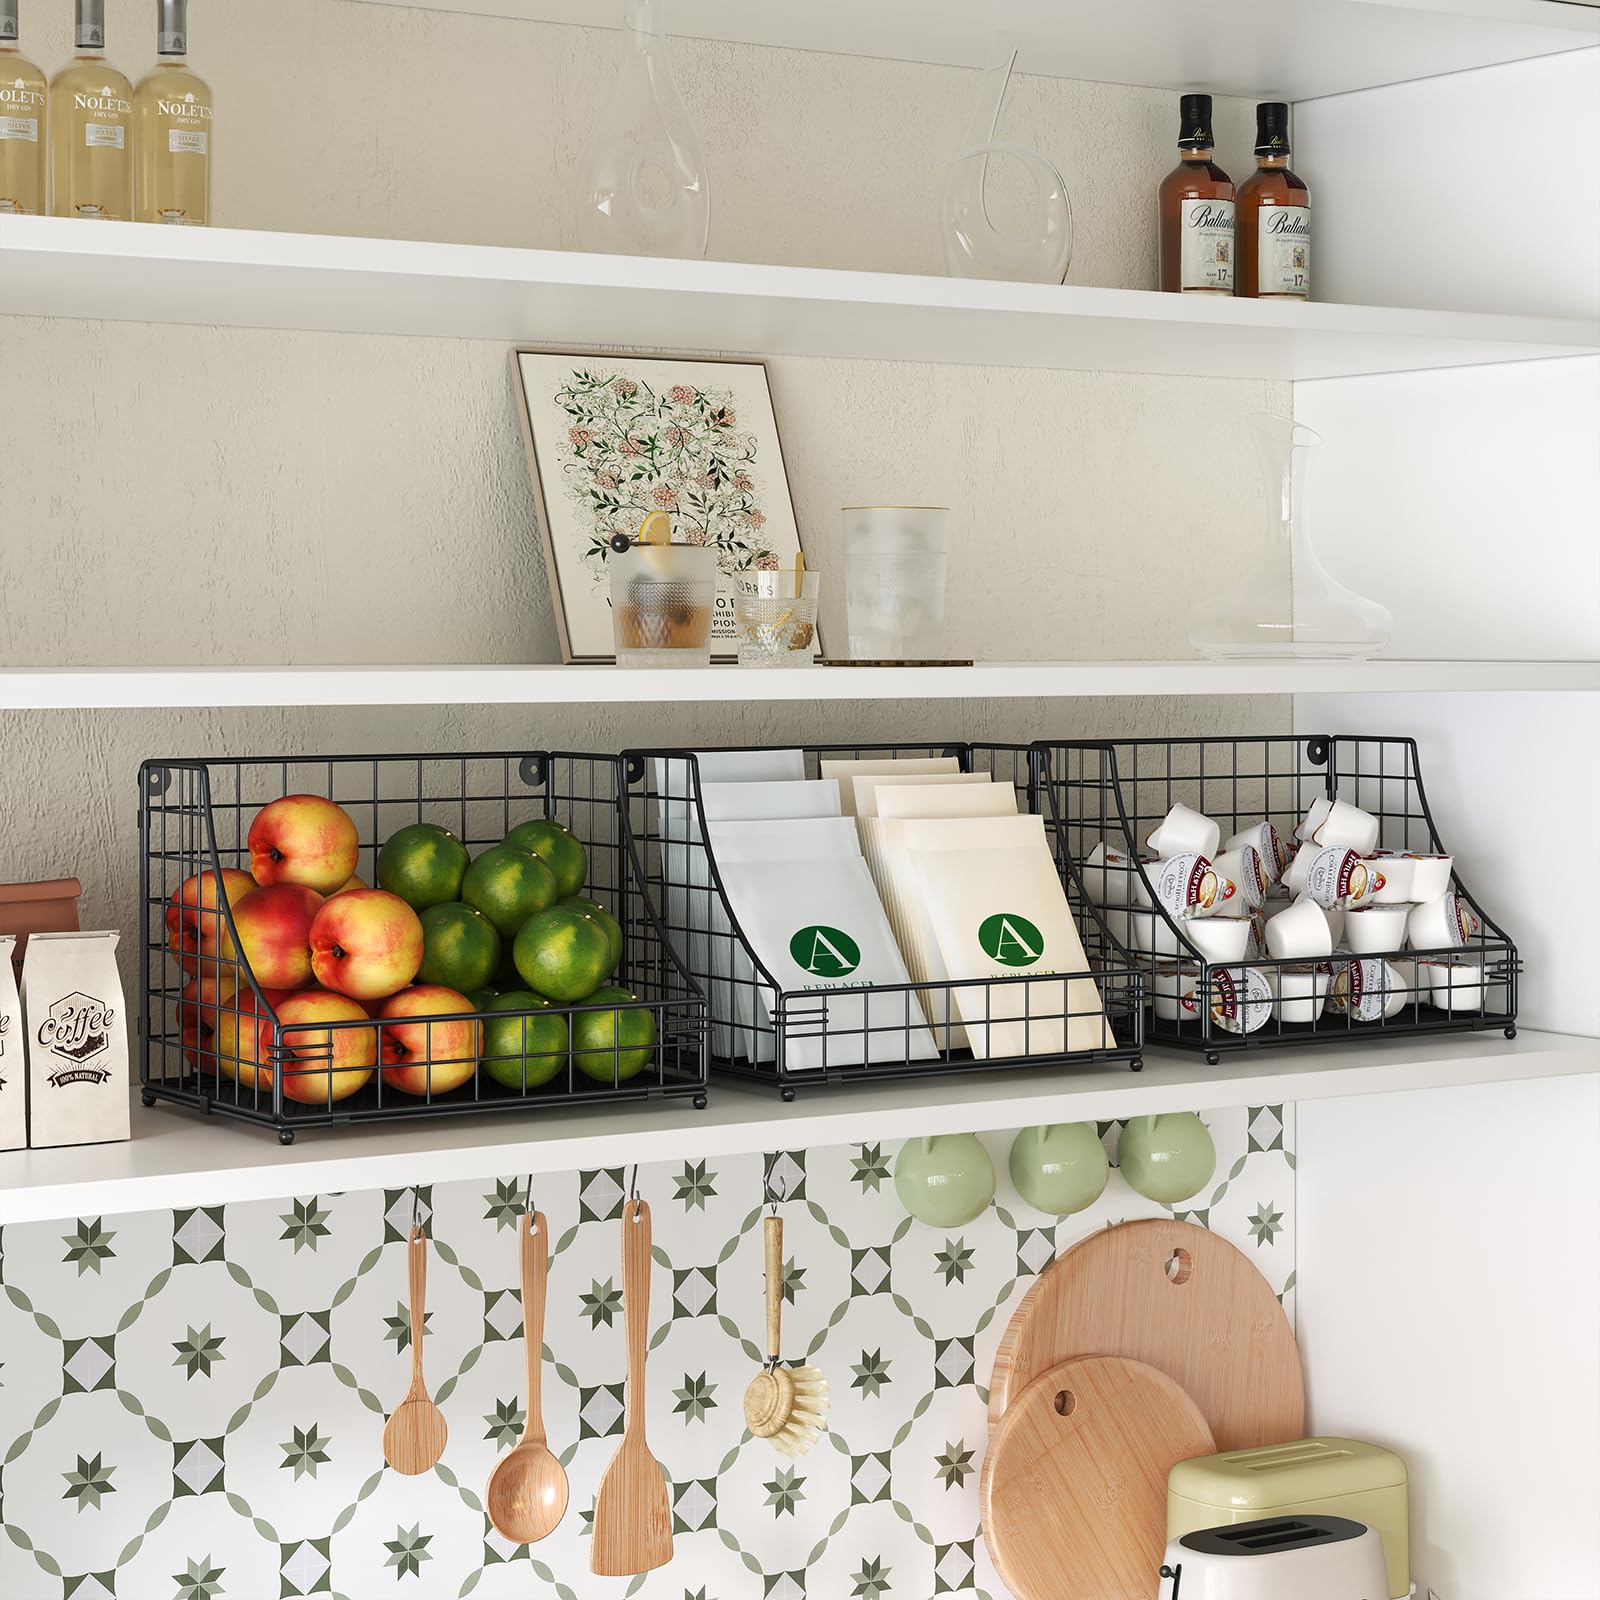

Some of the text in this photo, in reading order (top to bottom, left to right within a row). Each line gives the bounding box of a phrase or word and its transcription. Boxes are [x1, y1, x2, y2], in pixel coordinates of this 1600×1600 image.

[0, 90, 45, 106] OLET'S
[1217, 269, 1228, 281] 17
[1294, 274, 1304, 287] 17
[37, 1005, 115, 1046] Coffee
[59, 1071, 99, 1085] 100% NATURAL
